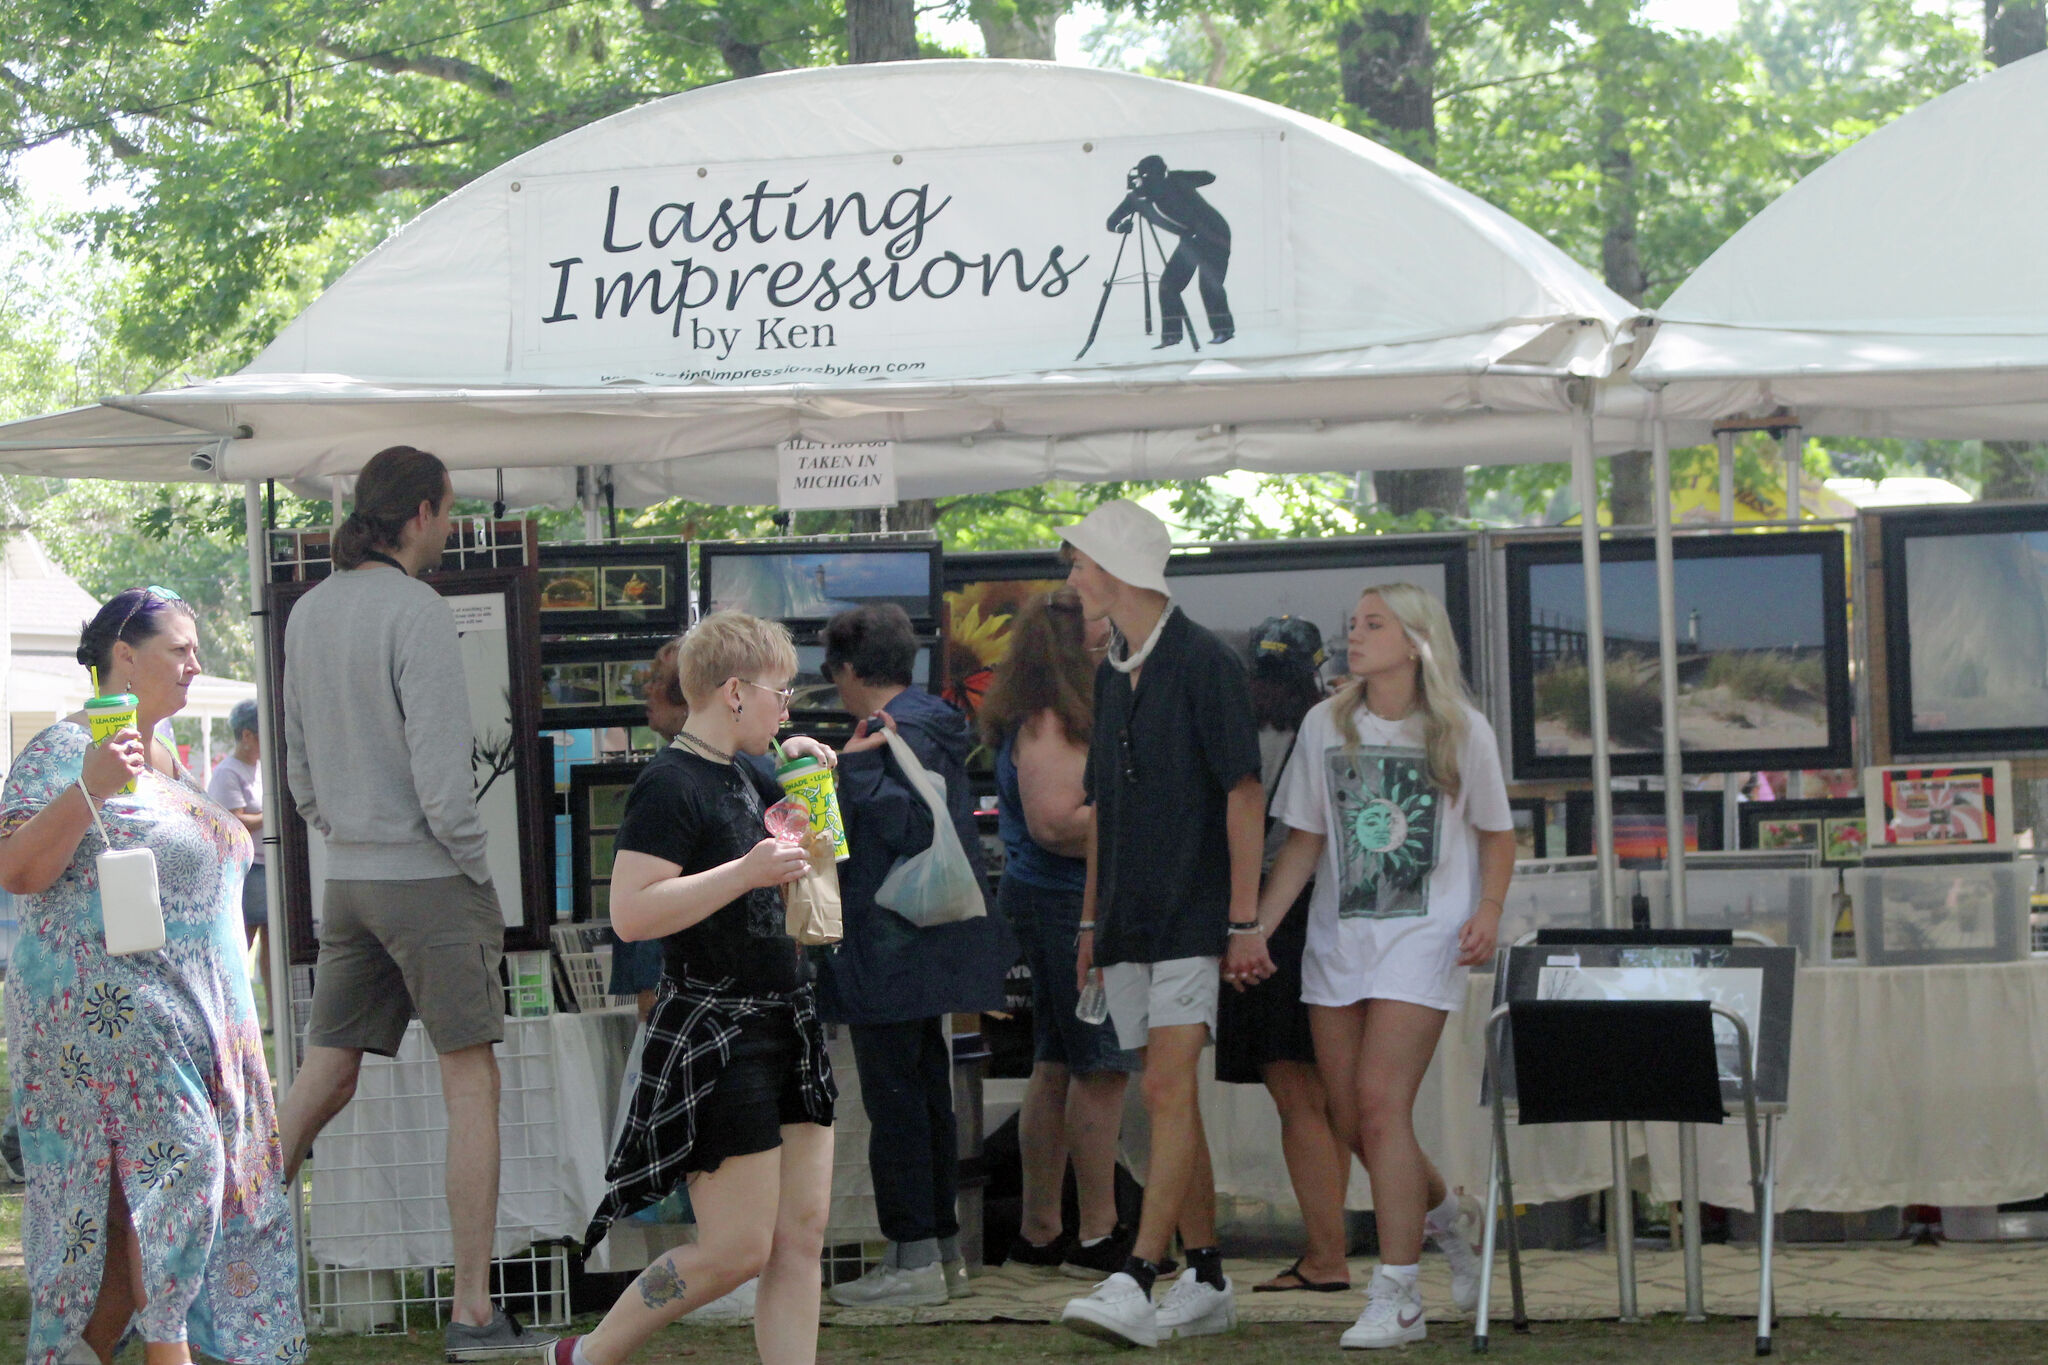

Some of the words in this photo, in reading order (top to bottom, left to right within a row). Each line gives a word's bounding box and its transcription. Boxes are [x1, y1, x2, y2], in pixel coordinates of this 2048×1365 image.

[602, 179, 953, 261] Lasting
[541, 243, 1091, 337] Impressions
[690, 317, 742, 361] by
[755, 317, 838, 351] Ken
[793, 473, 883, 490] MICHIGAN
[798, 455, 854, 470] TAKEN
[858, 453, 878, 468] IN
